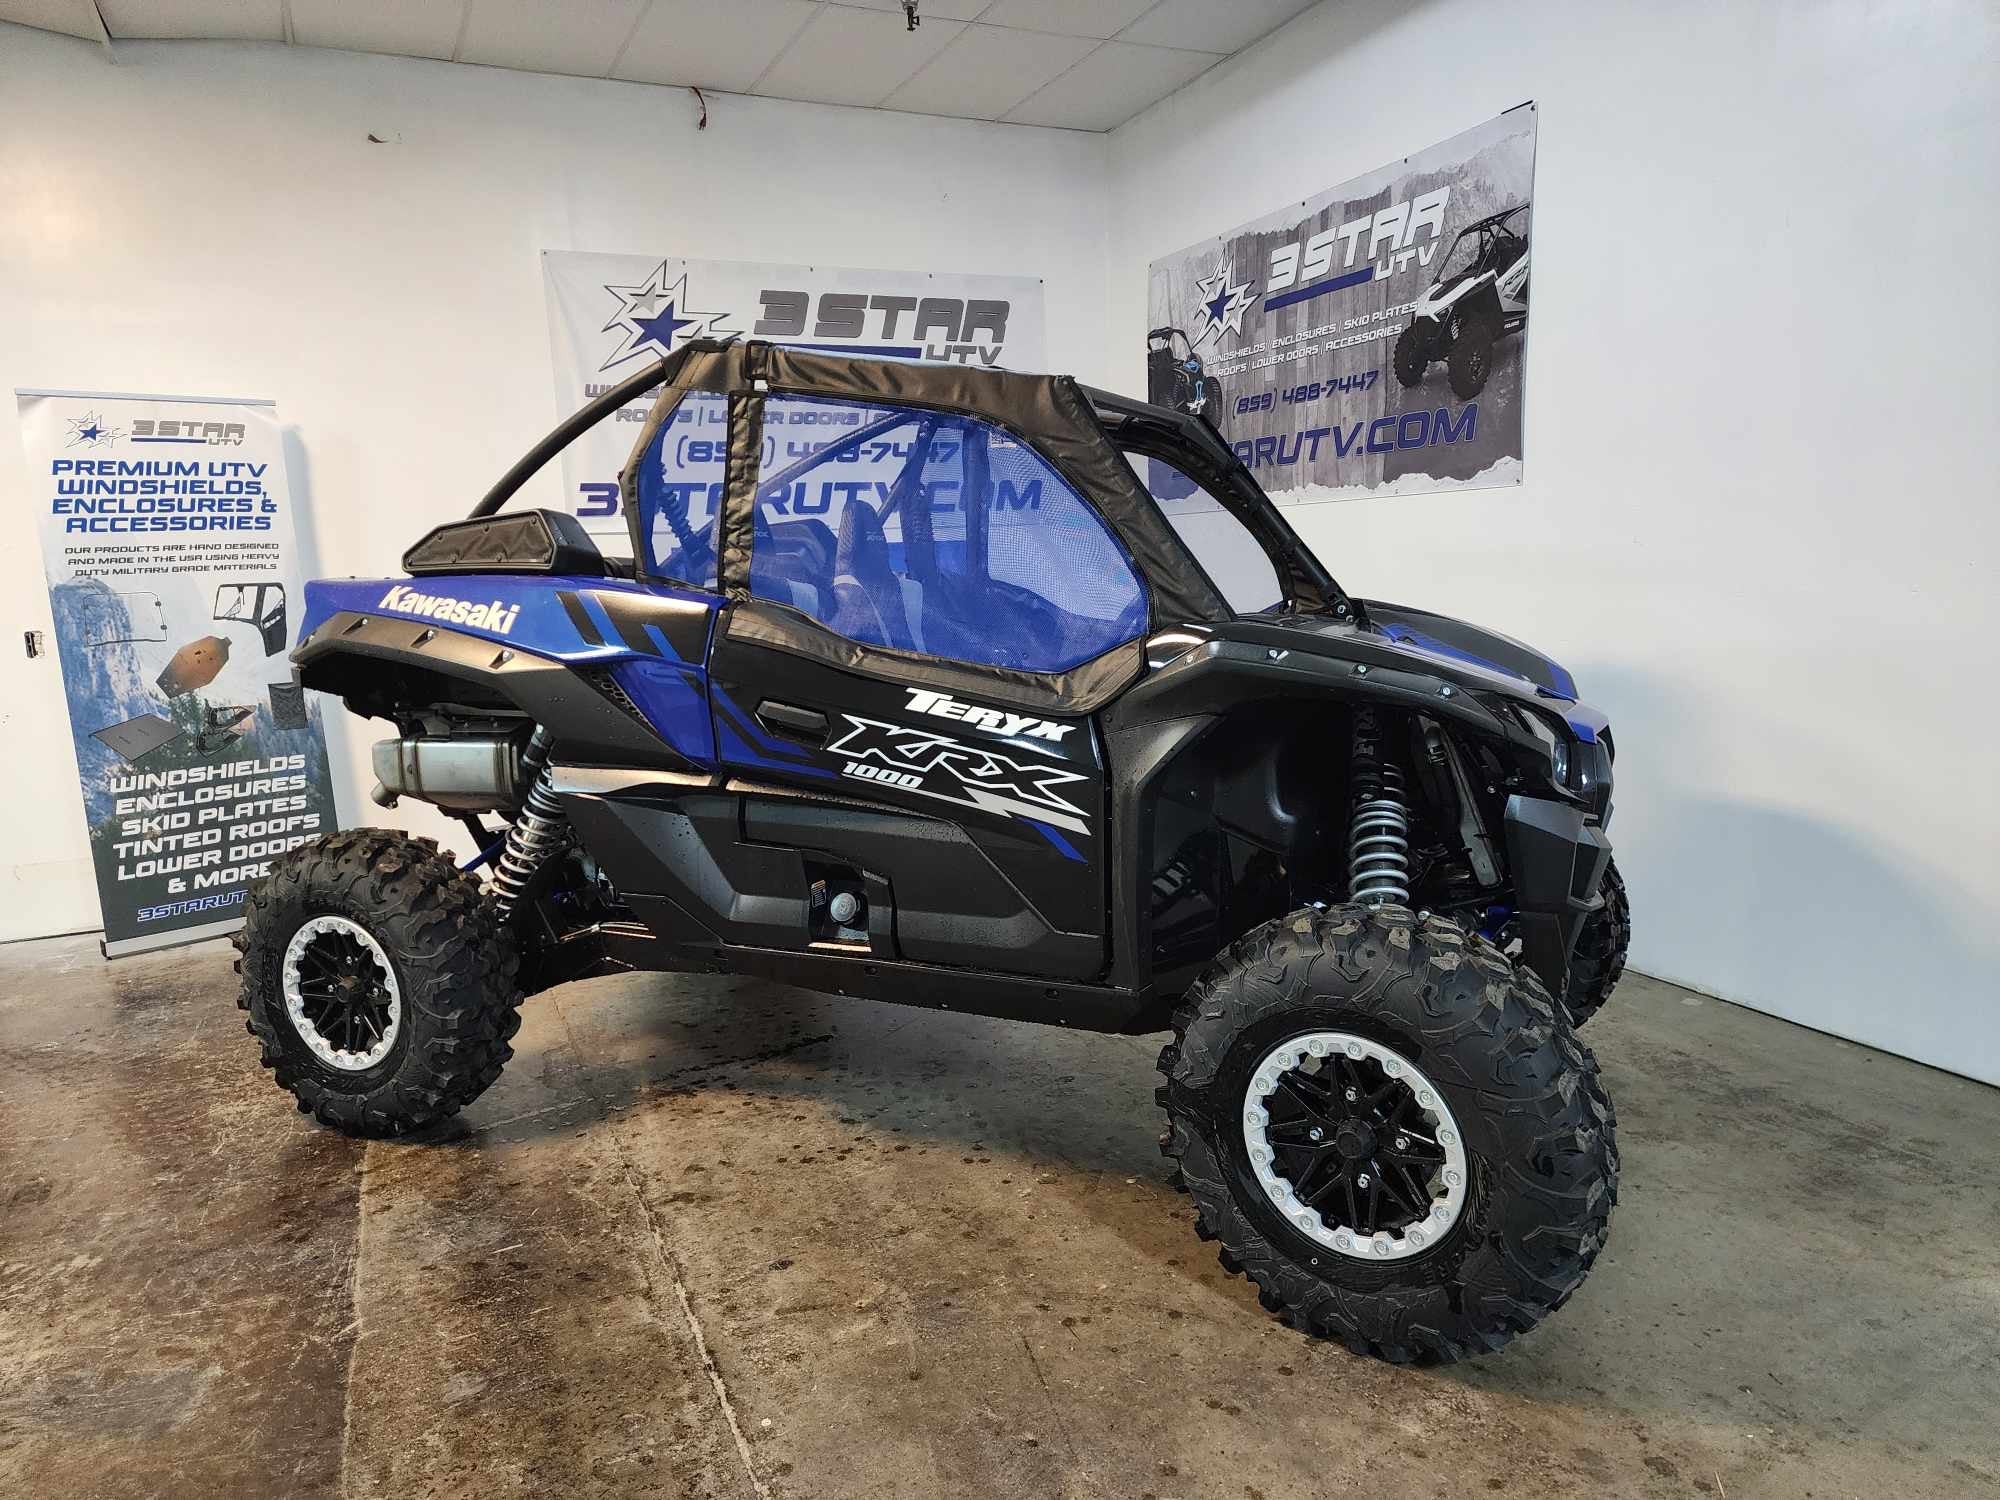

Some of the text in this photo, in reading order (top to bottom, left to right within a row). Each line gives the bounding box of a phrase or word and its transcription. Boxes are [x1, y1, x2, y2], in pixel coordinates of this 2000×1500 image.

[1372, 242, 1438, 281] UTV
[1207, 301, 1419, 365] WINDSHIELDS ENCLOSURES SKID PLATES
[926, 344, 1002, 364] UTV
[1216, 324, 1403, 377] ROOFS LOWER DOORS ACCESSORIES
[1233, 370, 1379, 419] (859) 488-7447
[615, 408, 694, 423] ROS
[789, 411, 859, 425] DOORS
[207, 437, 243, 447] UTV
[676, 435, 776, 469] (85)
[52, 460, 268, 477] PREMIUM UTV
[57, 479, 267, 497] WINDSHIELDS,
[52, 498, 277, 514] ENCLOSURES &
[66, 515, 271, 533] ACCESSORIES
[65, 546, 91, 554] OUR
[94, 545, 159, 553] PRODUCTS
[152, 555, 176, 563] THE
[75, 563, 277, 577] DUTY MILITARY GRADE MATERIALS
[378, 585, 520, 635] Kawasaki
[110, 754, 305, 793] WINDSHIELDS
[843, 761, 925, 788] 1000
[116, 774, 306, 815] ENCLOSURES
[121, 794, 307, 837] SKID PLATES
[113, 813, 321, 859] TINTED ROOFS
[117, 850, 222, 881] LOWER
[168, 861, 273, 894] & MORE
[137, 889, 249, 922] 3STARUT
